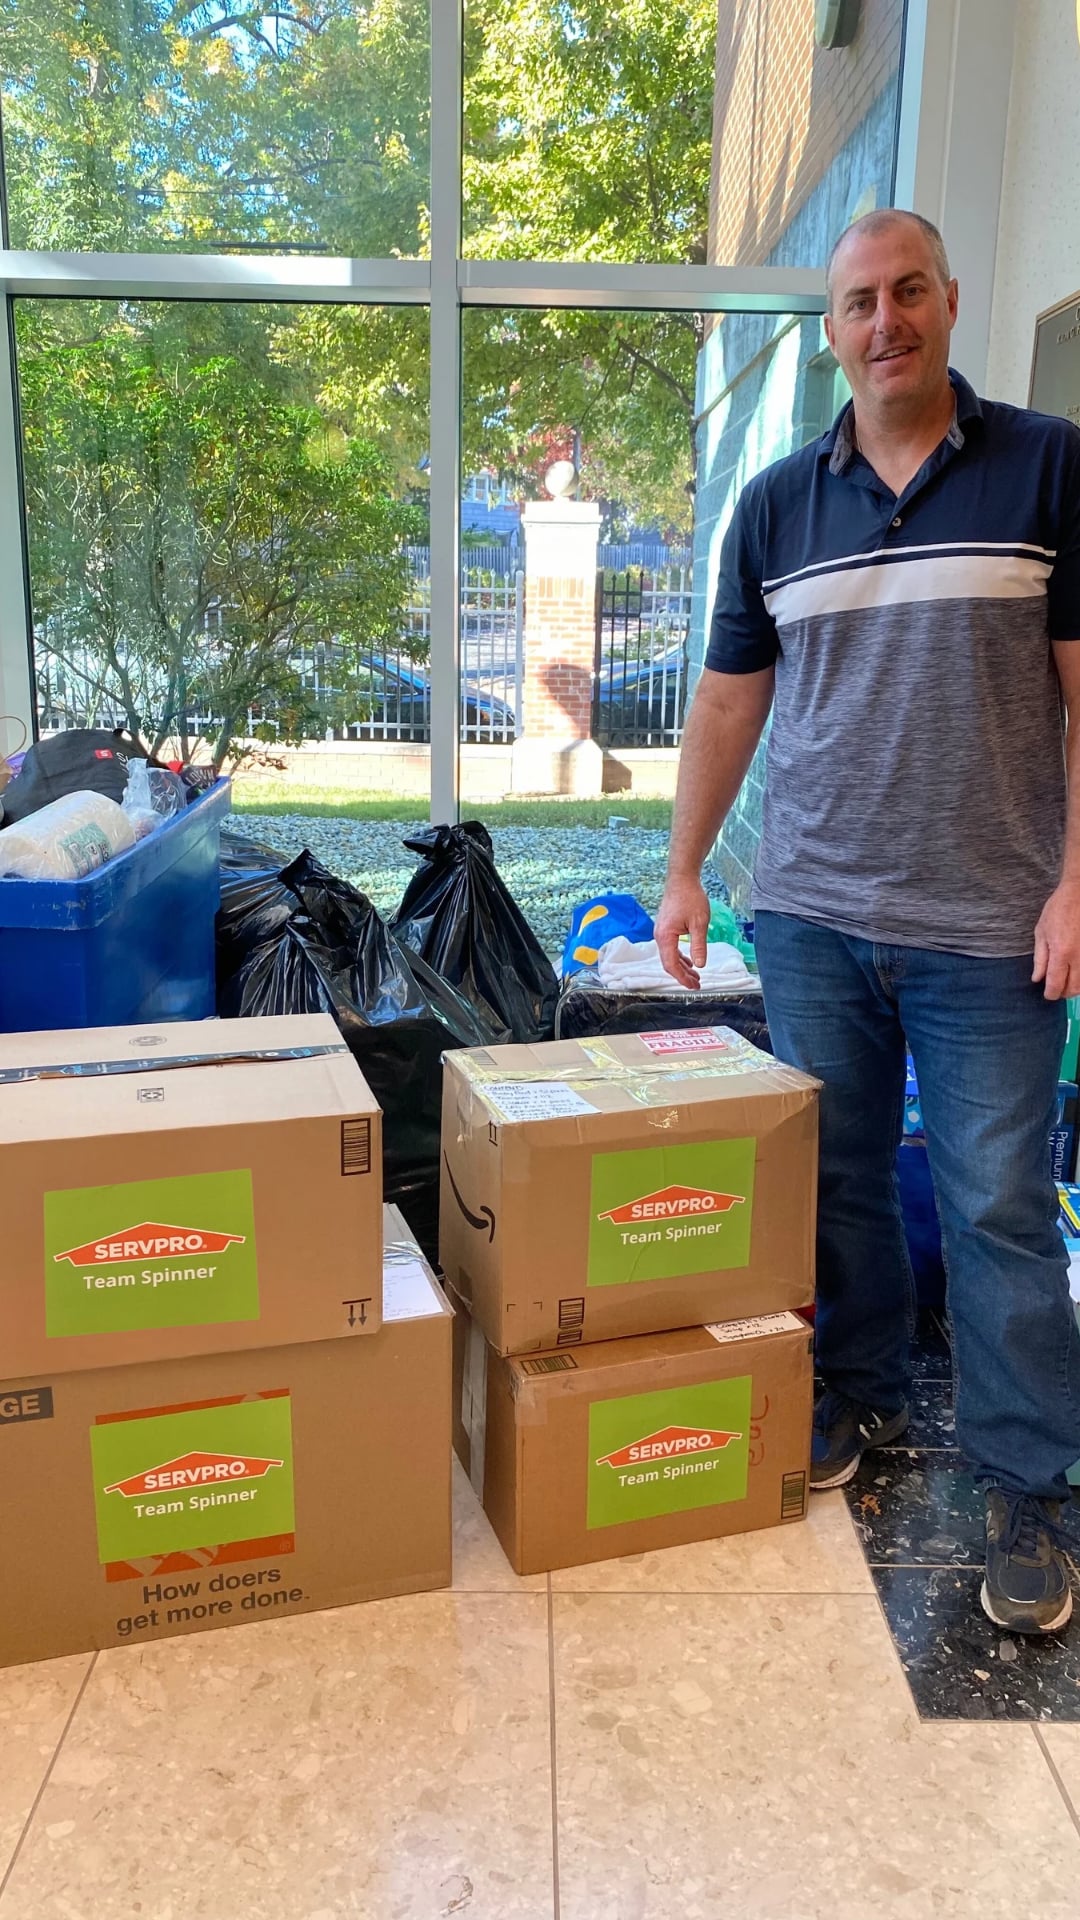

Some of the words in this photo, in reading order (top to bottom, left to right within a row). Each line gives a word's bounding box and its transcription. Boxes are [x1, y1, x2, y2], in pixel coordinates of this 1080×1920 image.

[1053, 1131, 1069, 1181] Premium
[631, 1196, 716, 1218] SERVPRO
[94, 1234, 205, 1260] SERVPRO
[620, 1231, 661, 1245] Team
[665, 1222, 722, 1242] Spinner
[83, 1274, 136, 1290] Team
[141, 1266, 217, 1288] Spinner
[629, 1434, 713, 1460] SERVPRO
[144, 1461, 247, 1489] SERVPRO
[618, 1471, 659, 1487] Team
[663, 1459, 720, 1480] Spinner
[133, 1501, 184, 1518] Team
[189, 1489, 258, 1511] Spinner
[143, 1582, 200, 1604] How
[208, 1568, 282, 1593] doers
[116, 1609, 160, 1637] get
[167, 1600, 233, 1624] more
[240, 1588, 311, 1610] done.
